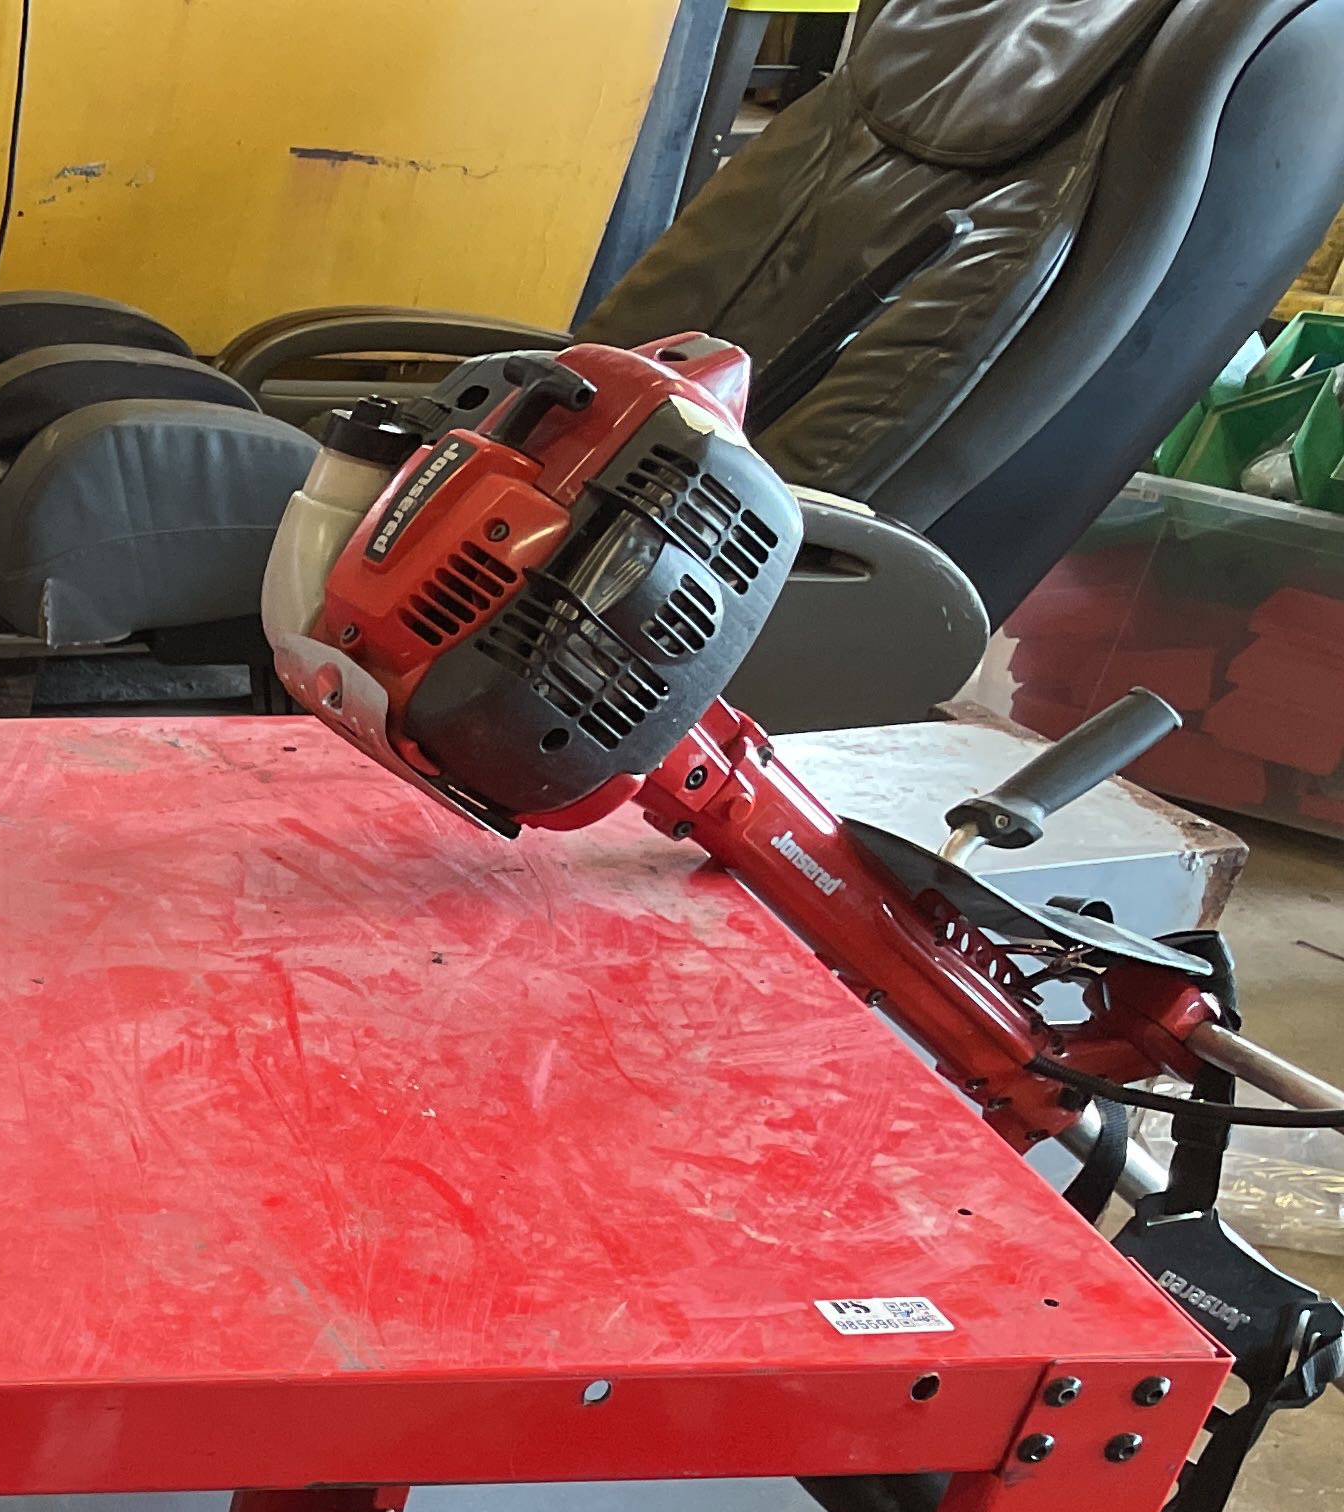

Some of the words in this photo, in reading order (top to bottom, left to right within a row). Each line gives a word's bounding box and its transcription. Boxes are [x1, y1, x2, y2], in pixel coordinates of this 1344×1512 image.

[373, 442, 459, 554] Jonsered
[770, 830, 843, 896] Jonsered
[1157, 1270, 1251, 1331] Jonsered
